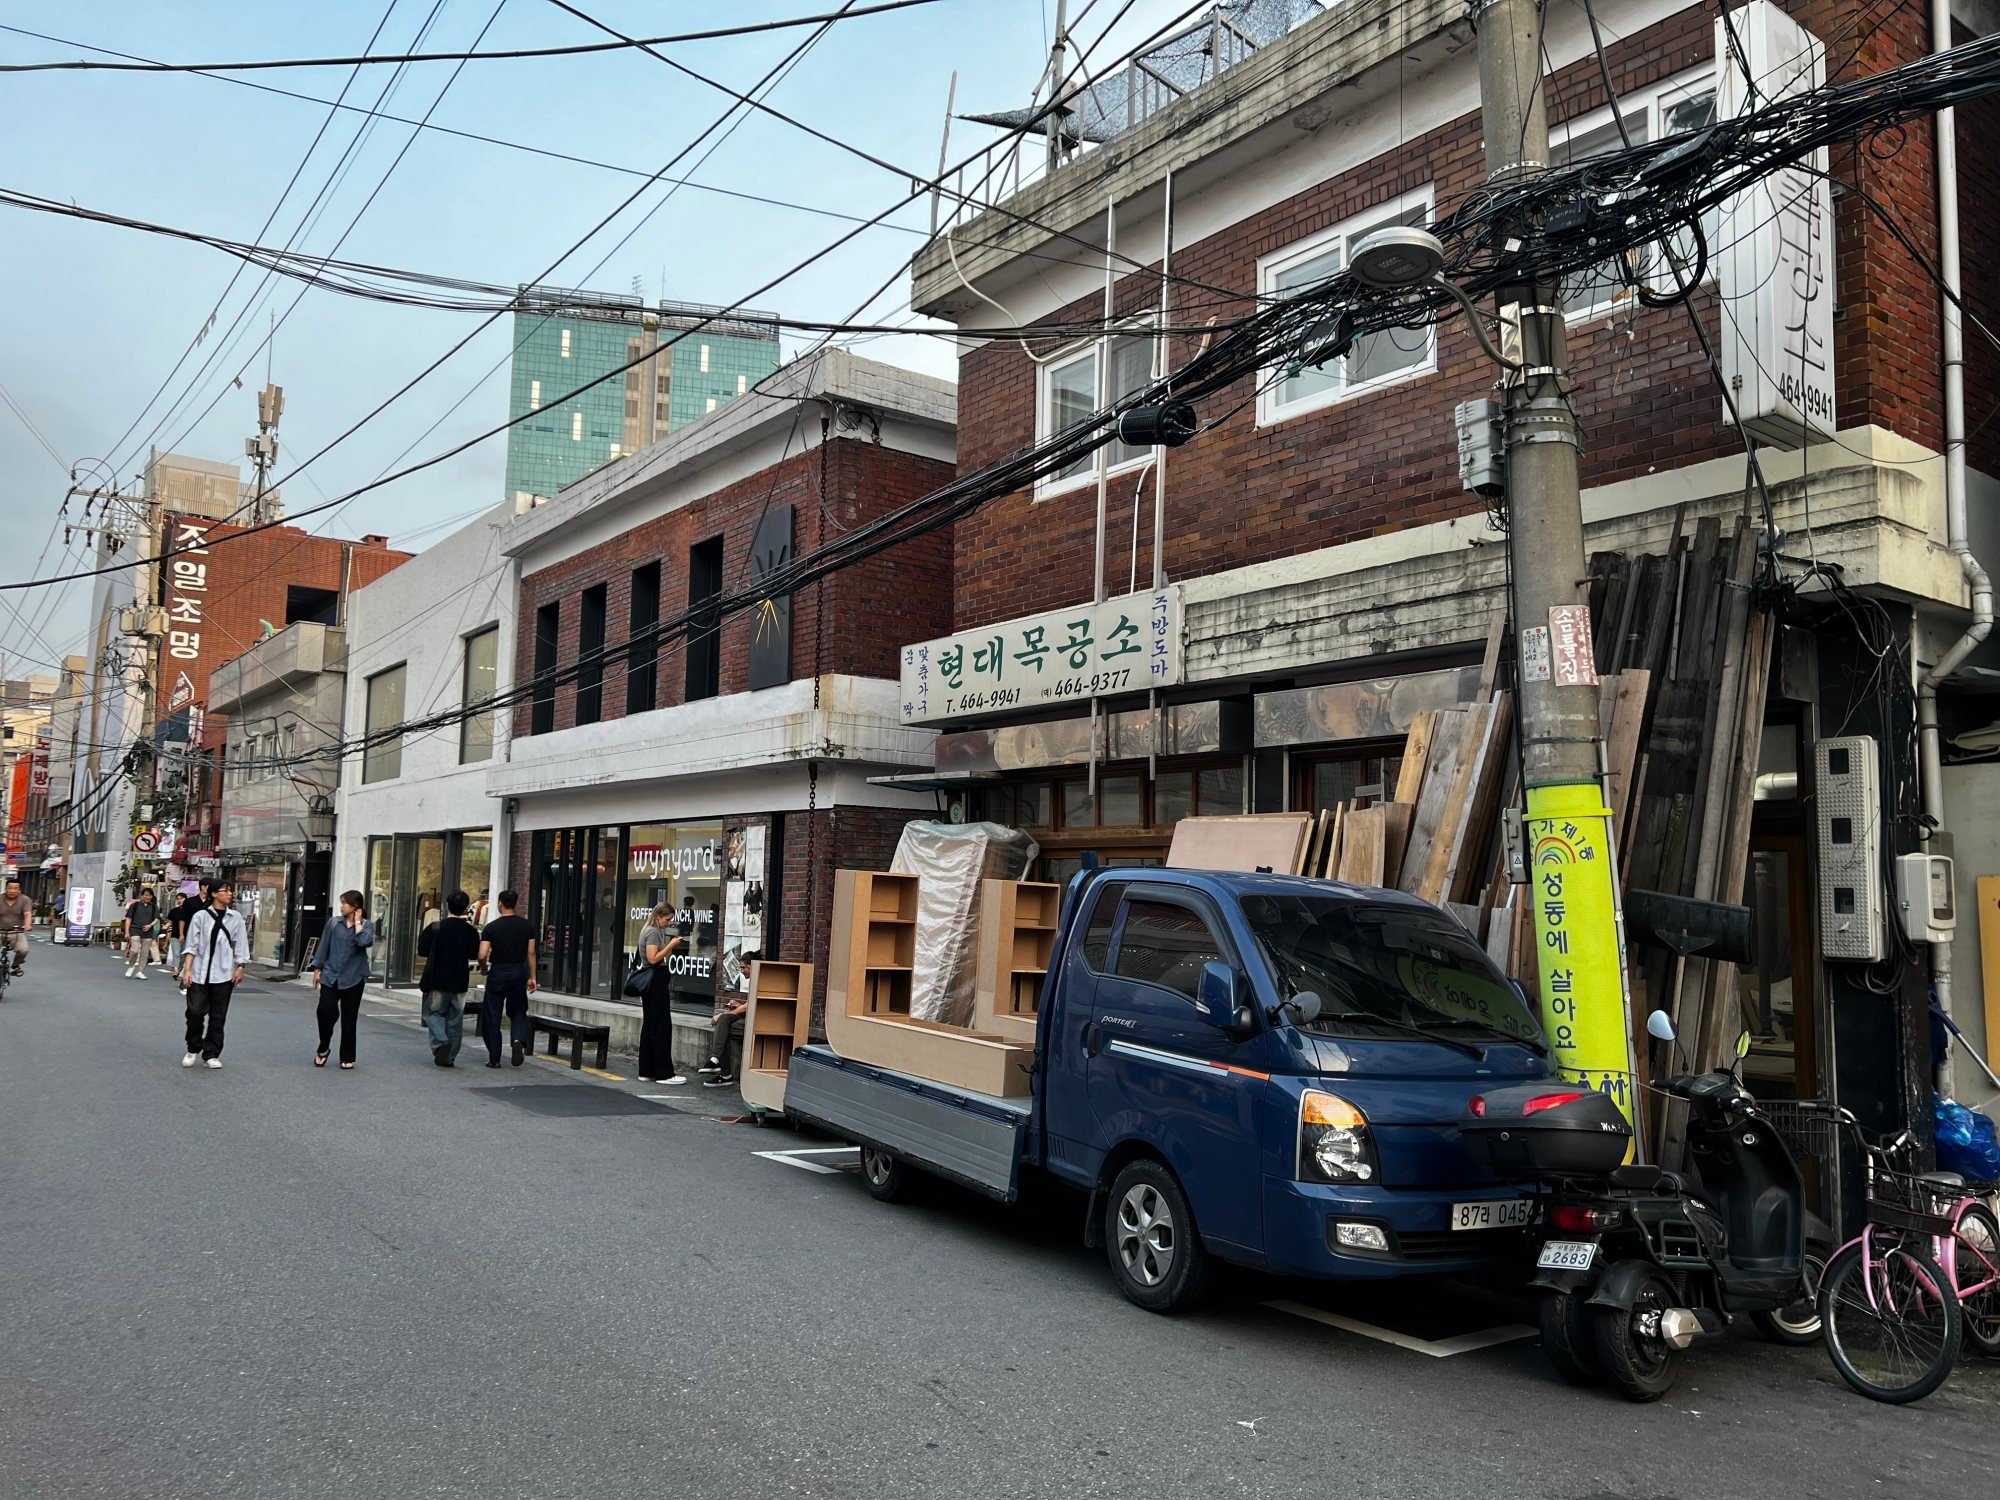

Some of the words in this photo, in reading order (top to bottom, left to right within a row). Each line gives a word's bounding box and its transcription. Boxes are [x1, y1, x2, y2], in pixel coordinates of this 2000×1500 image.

[1779, 372, 1833, 422] 464-9941
[169, 523, 209, 659] 조일조명
[937, 614, 1143, 690] 현대목공소
[1150, 595, 1169, 678] 주방도마
[1554, 609, 1578, 683] 솜틀집
[918, 646, 929, 716] 맞춤가구
[959, 687, 1021, 711] 464-9941
[1054, 668, 1131, 698] 464-9377
[33, 738, 50, 786] 노래방
[633, 838, 716, 880] wynyard
[694, 909, 714, 924] WINE
[1542, 872, 1569, 954] 성동에
[668, 954, 710, 978] COFFEE
[1550, 968, 1577, 1050] 살아요
[1460, 1205, 1490, 1227] 87라
[1552, 1251, 1587, 1265] 2683
